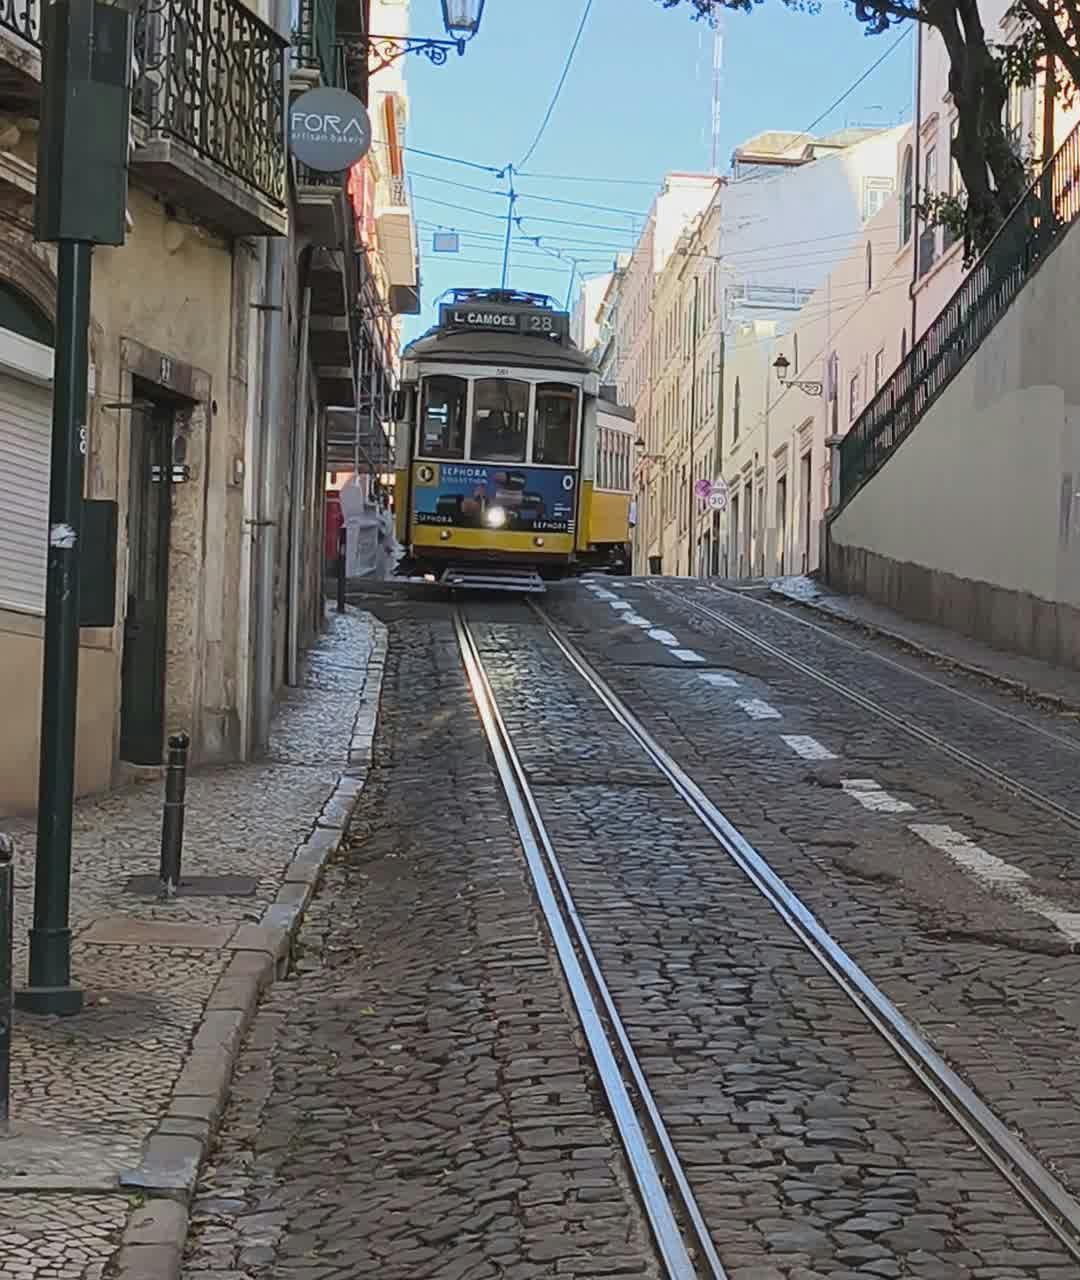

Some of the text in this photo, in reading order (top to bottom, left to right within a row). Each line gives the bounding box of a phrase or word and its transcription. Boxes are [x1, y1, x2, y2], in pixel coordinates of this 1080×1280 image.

[291, 112, 364, 135] FORA
[530, 316, 552, 331] 28
[442, 467, 487, 477] SEPHORA
